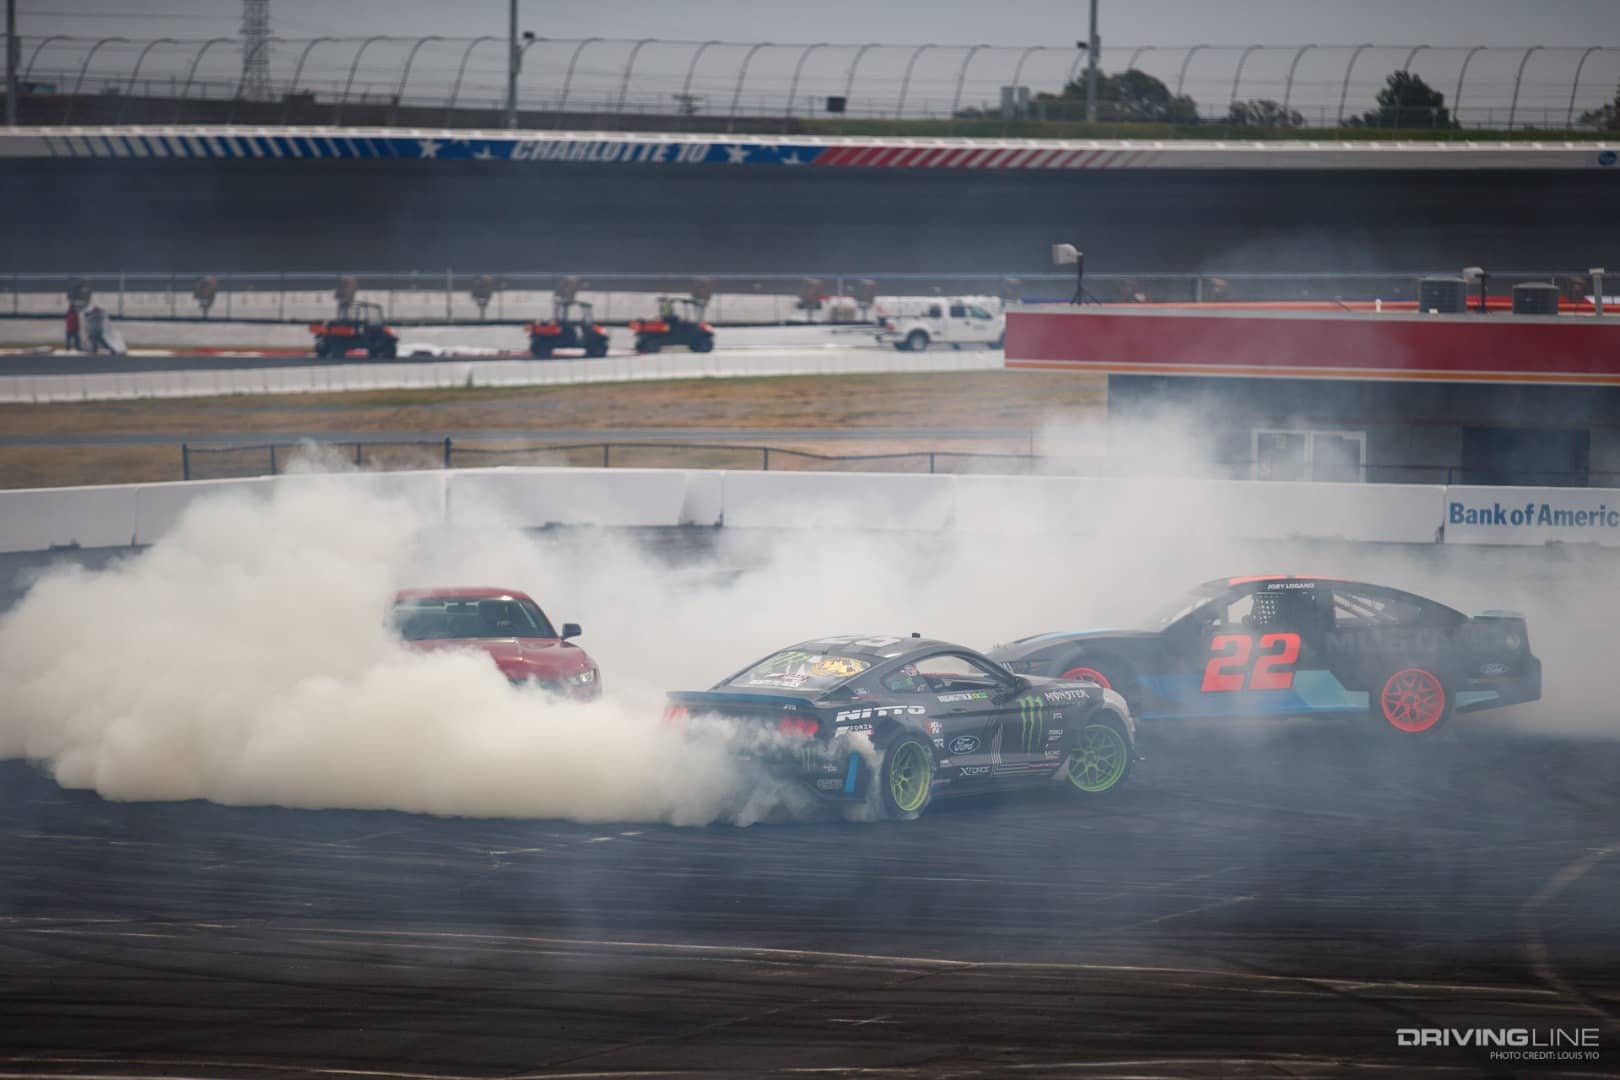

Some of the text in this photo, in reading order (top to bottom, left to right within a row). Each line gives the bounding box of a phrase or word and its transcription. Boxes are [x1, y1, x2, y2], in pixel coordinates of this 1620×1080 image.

[509, 141, 674, 163] CHARLOTTE
[1449, 502, 1508, 526] Bank
[1510, 503, 1535, 526] of
[1201, 632, 1301, 693] 22
[1044, 689, 1090, 702] MONSTER
[835, 705, 927, 722] NITTO
[953, 737, 977, 753] Ford
